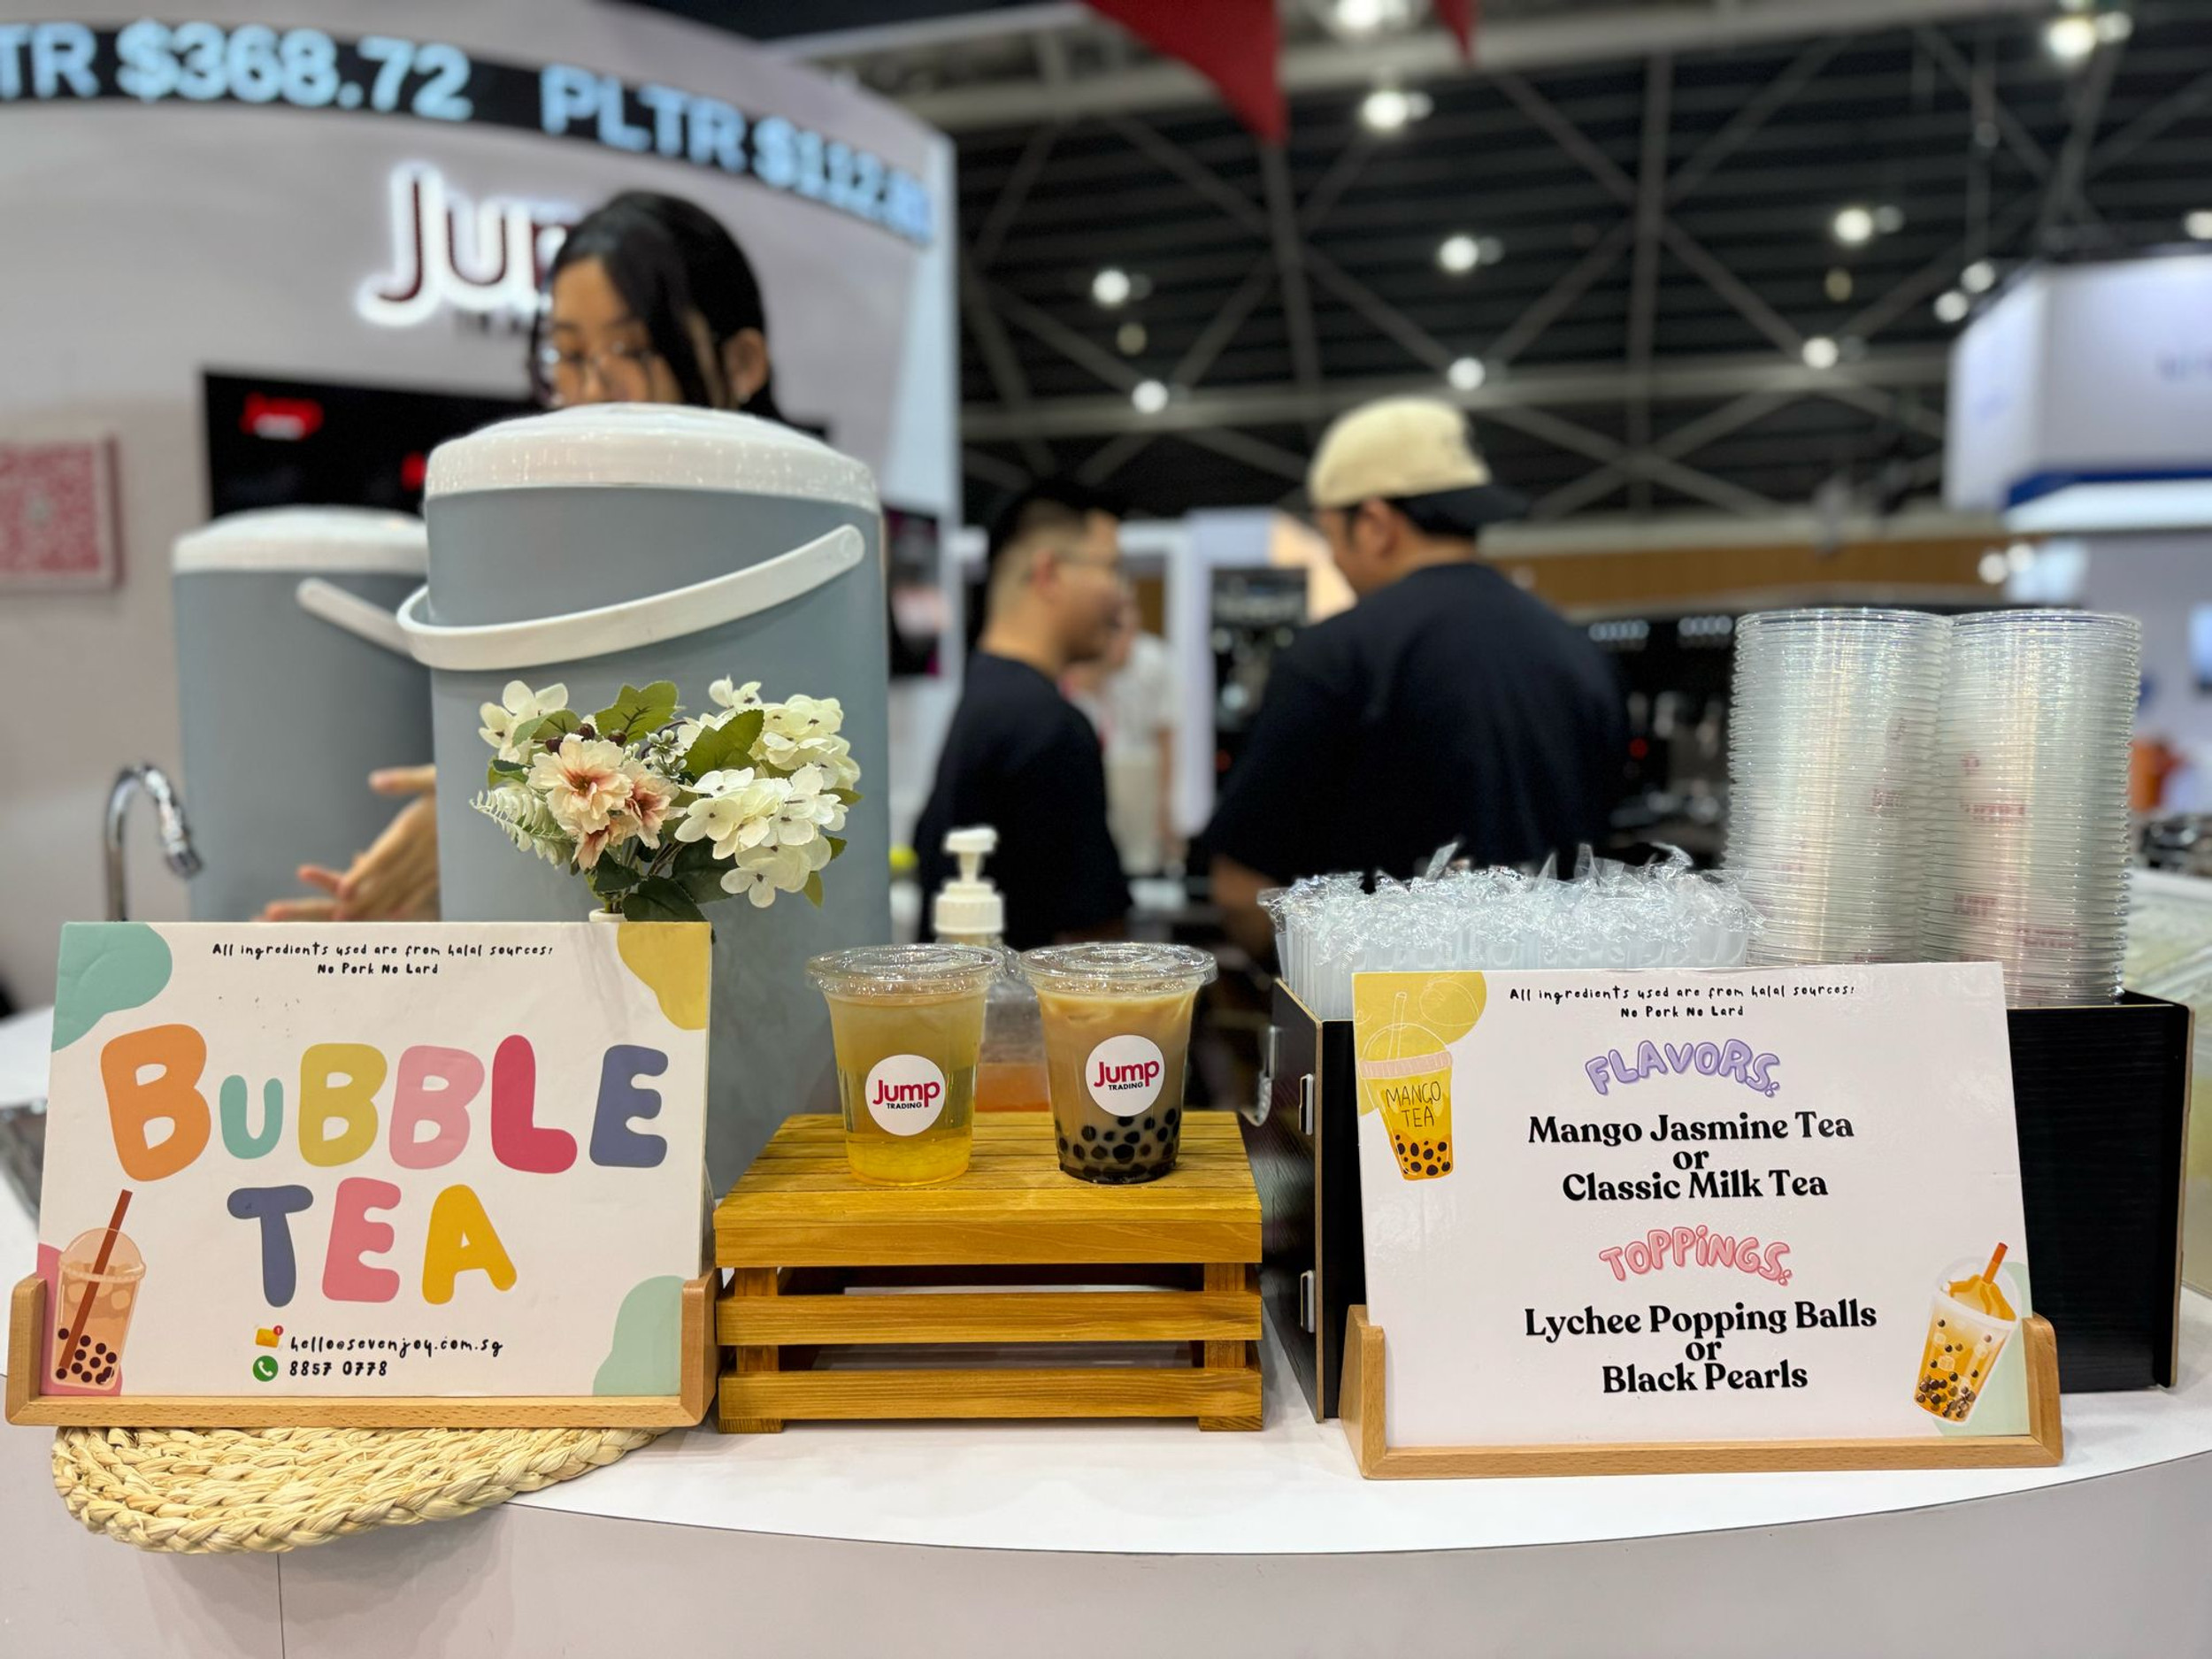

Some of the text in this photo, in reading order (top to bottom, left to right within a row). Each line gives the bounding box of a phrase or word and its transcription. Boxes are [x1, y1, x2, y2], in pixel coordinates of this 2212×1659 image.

[115, 17, 473, 122] $368.72
[540, 64, 746, 173] PLTR
[211, 942, 234, 957] All
[241, 941, 329, 961] ingredients
[335, 942, 367, 958] used
[373, 945, 398, 956] are
[404, 944, 441, 958] from
[447, 943, 482, 957] halal
[316, 961, 439, 976] No Pork No Lard
[1509, 987, 1532, 1002] All
[1538, 985, 1630, 1005] ingredients
[1636, 986, 1670, 1001] used
[1676, 987, 1701, 998] are
[1708, 986, 1745, 1001] from
[1750, 984, 1786, 999] halal
[1619, 1004, 1744, 1019] No Pork No Lard
[1093, 1060, 1160, 1087] Jump
[1108, 1081, 1144, 1091] TRADING
[100, 1023, 670, 1183] BUBBLE
[872, 1079, 941, 1108] Jump
[1386, 1080, 1441, 1108] MANGO
[1401, 1105, 1435, 1128] TEA
[1528, 1110, 1855, 1148] Mango Jasmine Tea
[1672, 1149, 1710, 1171] or
[1563, 1168, 1829, 1202] Classic Milk Tea
[227, 1177, 518, 1309] TEA
[1525, 1297, 1878, 1345] Lychee Popping Balls
[289, 1335, 504, 1359] hello@sevenjoy.com.sg
[1685, 1338, 1723, 1362] or
[288, 1359, 388, 1377] 8857 0778
[1601, 1359, 1809, 1394] Black Pearls
